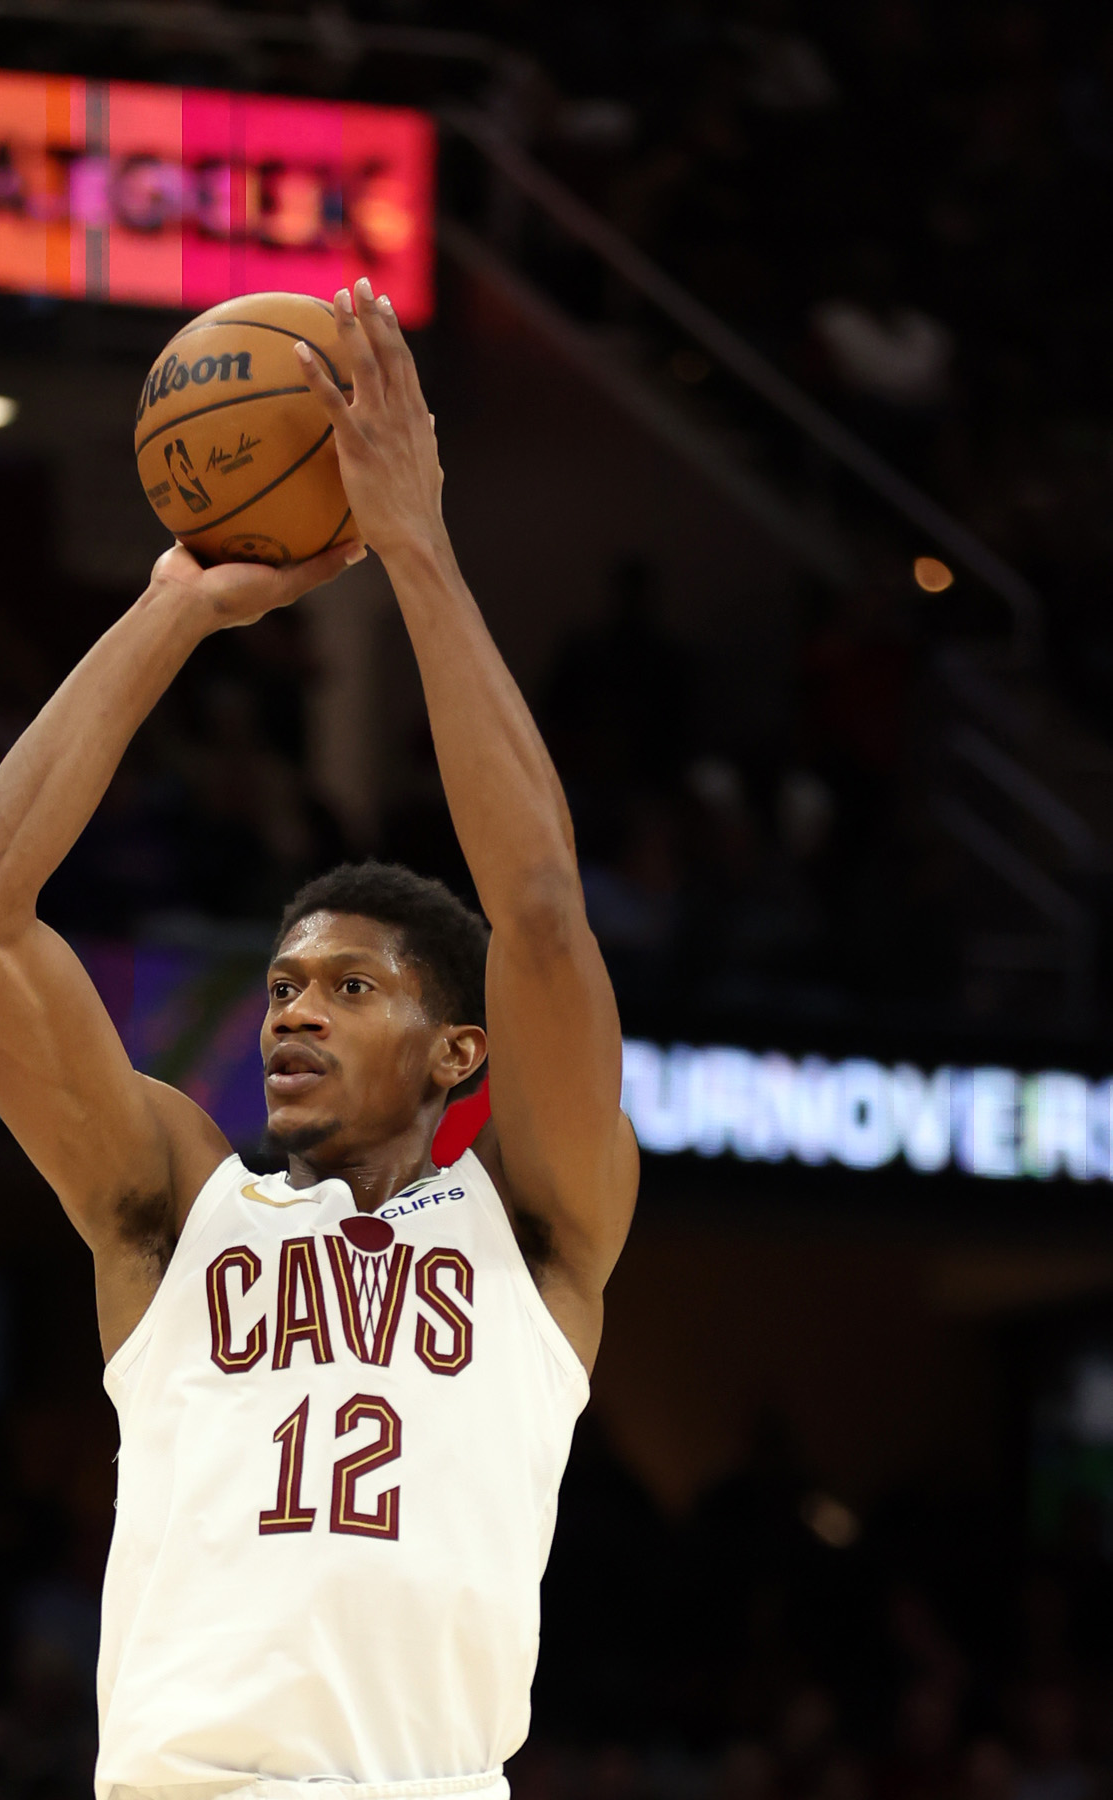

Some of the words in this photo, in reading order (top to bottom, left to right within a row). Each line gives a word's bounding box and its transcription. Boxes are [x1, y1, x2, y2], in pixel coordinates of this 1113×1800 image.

[136, 351, 253, 423] ilson
[621, 1036, 1113, 1182] URNOVERS
[380, 1187, 465, 1220] CLIFFS
[206, 1234, 475, 1377] CAVS
[259, 1393, 402, 1541] 12
